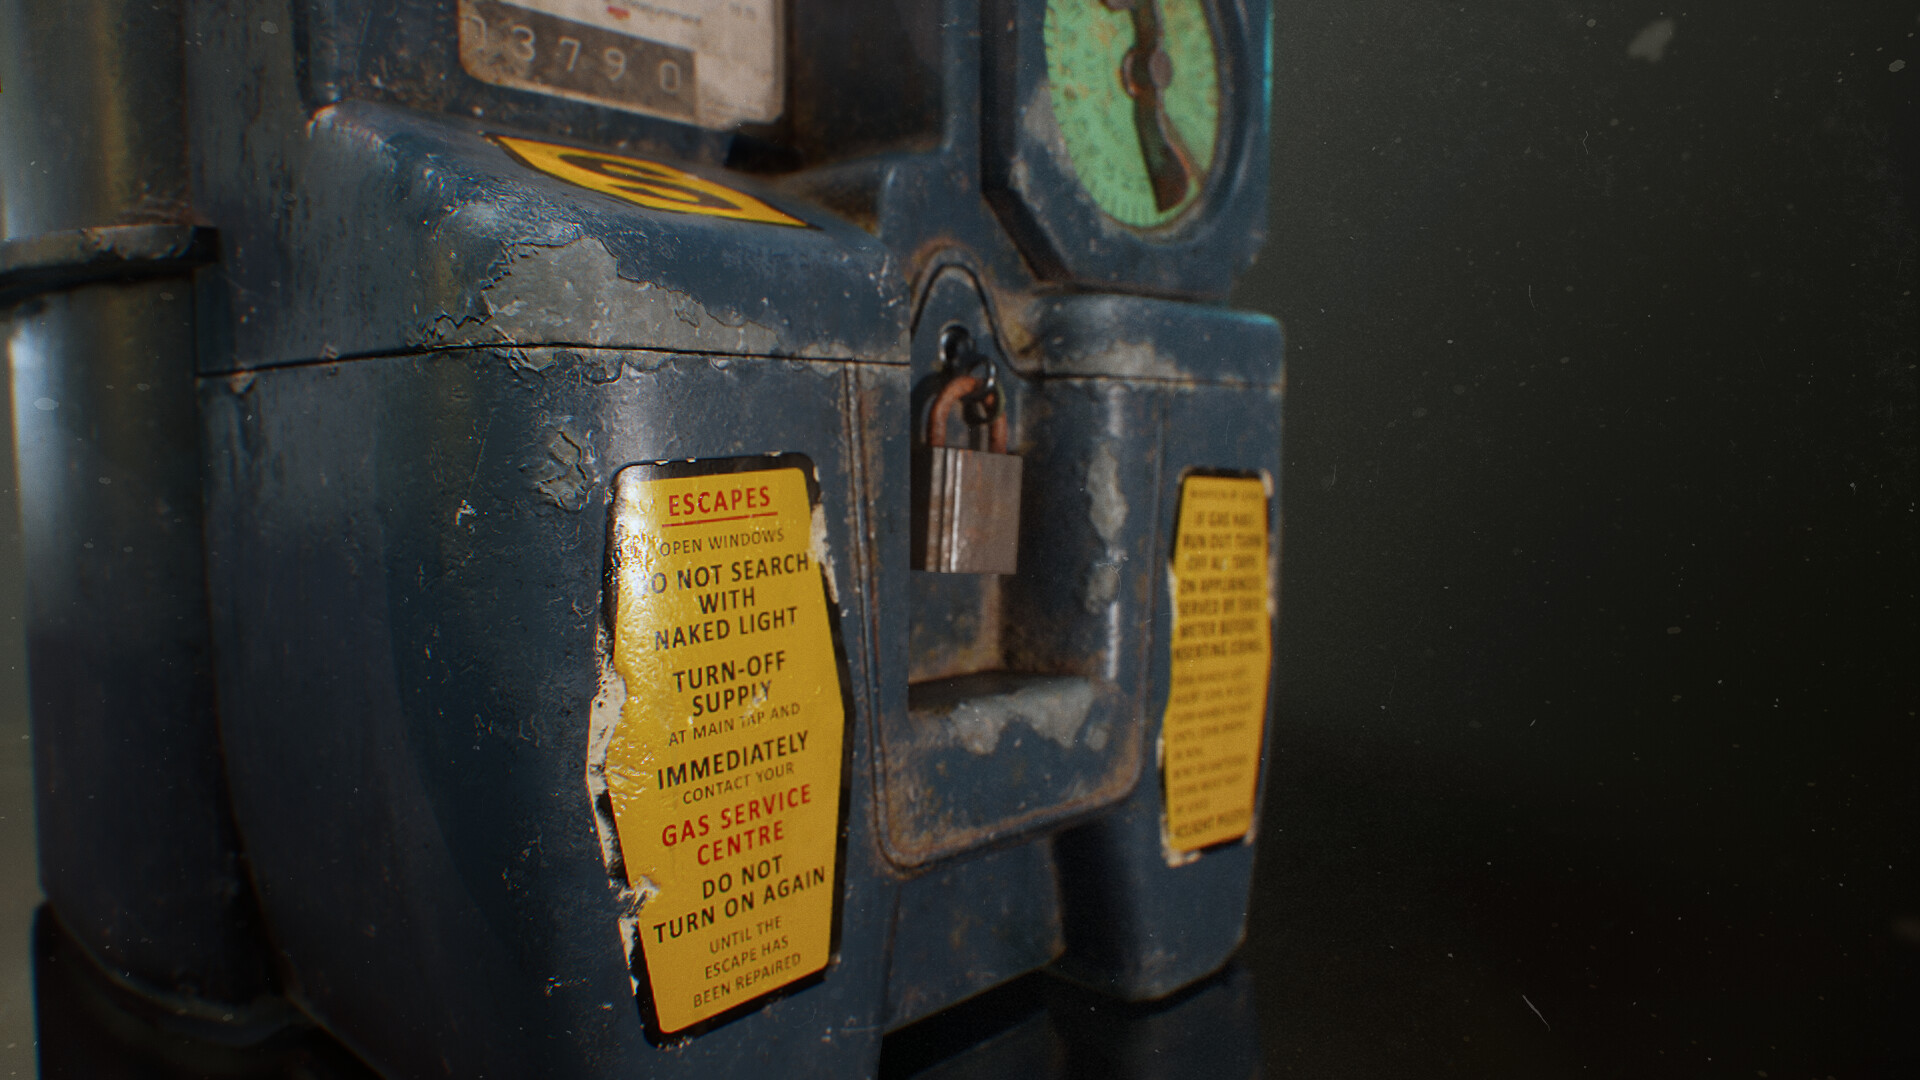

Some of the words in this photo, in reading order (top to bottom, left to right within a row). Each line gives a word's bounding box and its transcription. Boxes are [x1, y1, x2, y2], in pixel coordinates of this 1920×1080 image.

[668, 486, 771, 517] ESCAPES
[660, 538, 702, 557] OPEN
[708, 528, 785, 550] WINDOWS
[677, 564, 723, 590] NOT
[731, 552, 809, 582] SEARCH
[698, 587, 756, 614] WITH
[654, 619, 730, 651] NAKED
[740, 606, 798, 635] LIGHT
[672, 650, 787, 693] TURN-OFF
[692, 680, 772, 717] SUPPLY
[668, 731, 687, 747] AT
[693, 717, 735, 741] MAIN
[770, 702, 800, 720] AND
[657, 730, 809, 790] IMMEDIATELY
[683, 775, 751, 804] CONTACT
[755, 762, 795, 784] YOUR
[661, 814, 710, 847] GAS
[720, 784, 812, 830] SERVICE
[697, 820, 785, 866] CENTRE
[702, 873, 732, 900] DO
[741, 855, 783, 887] NOT
[653, 905, 715, 944] TURN
[724, 892, 755, 918] ON
[763, 866, 825, 905] AGAIN
[705, 946, 757, 980] ESCAPE
[761, 935, 789, 957] HAS
[709, 929, 752, 955] UNTIL
[757, 916, 783, 937] THE
[693, 984, 731, 1009] BEEN
[735, 952, 801, 990] REPAIRED
